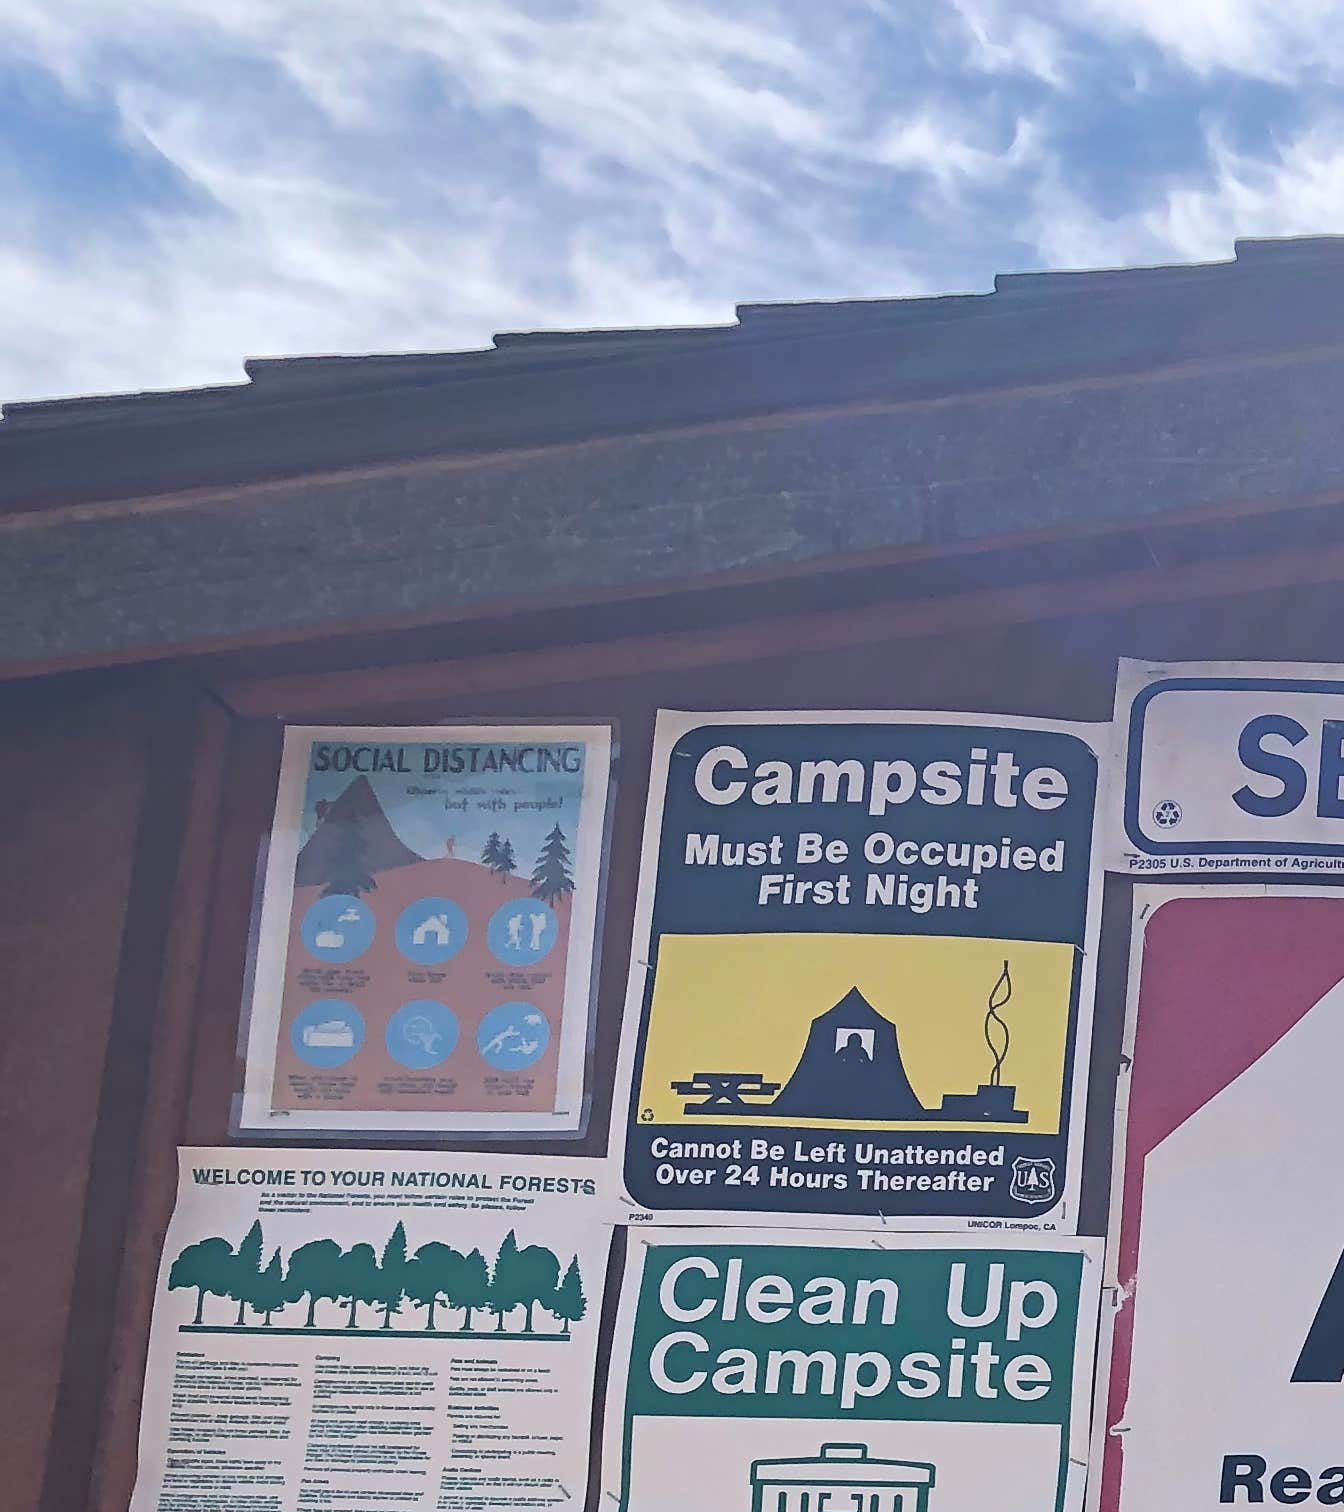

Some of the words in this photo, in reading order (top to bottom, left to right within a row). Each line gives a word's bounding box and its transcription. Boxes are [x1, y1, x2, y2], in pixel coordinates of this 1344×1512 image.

[313, 747, 411, 773] SOCIAL
[423, 747, 581, 774] DISTANCING
[694, 745, 1068, 815] Campsite
[685, 833, 783, 866] Must
[796, 833, 848, 863] Be
[864, 832, 1064, 874] Occupied
[1129, 858, 1166, 869] P2305
[1170, 857, 1193, 868] U.S.
[1198, 858, 1271, 869] Department
[1274, 859, 1287, 867] of
[758, 873, 850, 904] First
[865, 873, 978, 913] Night
[651, 1137, 742, 1159] Cannot
[750, 1139, 784, 1160] Be
[794, 1141, 846, 1163] Left
[855, 1143, 1004, 1165] Unattended
[192, 1168, 295, 1185] WELCOME
[300, 1170, 325, 1186] TO
[330, 1170, 384, 1186] YOUR
[391, 1171, 492, 1189] NATIONAL
[499, 1175, 595, 1195] FORESTS
[656, 1163, 716, 1184] Over
[724, 1164, 759, 1185] 24
[770, 1166, 847, 1189] Hours
[857, 1169, 994, 1191] Thereafter
[659, 1256, 898, 1324] Clean
[947, 1263, 1057, 1341] Up
[649, 1331, 1051, 1407] Campsite
